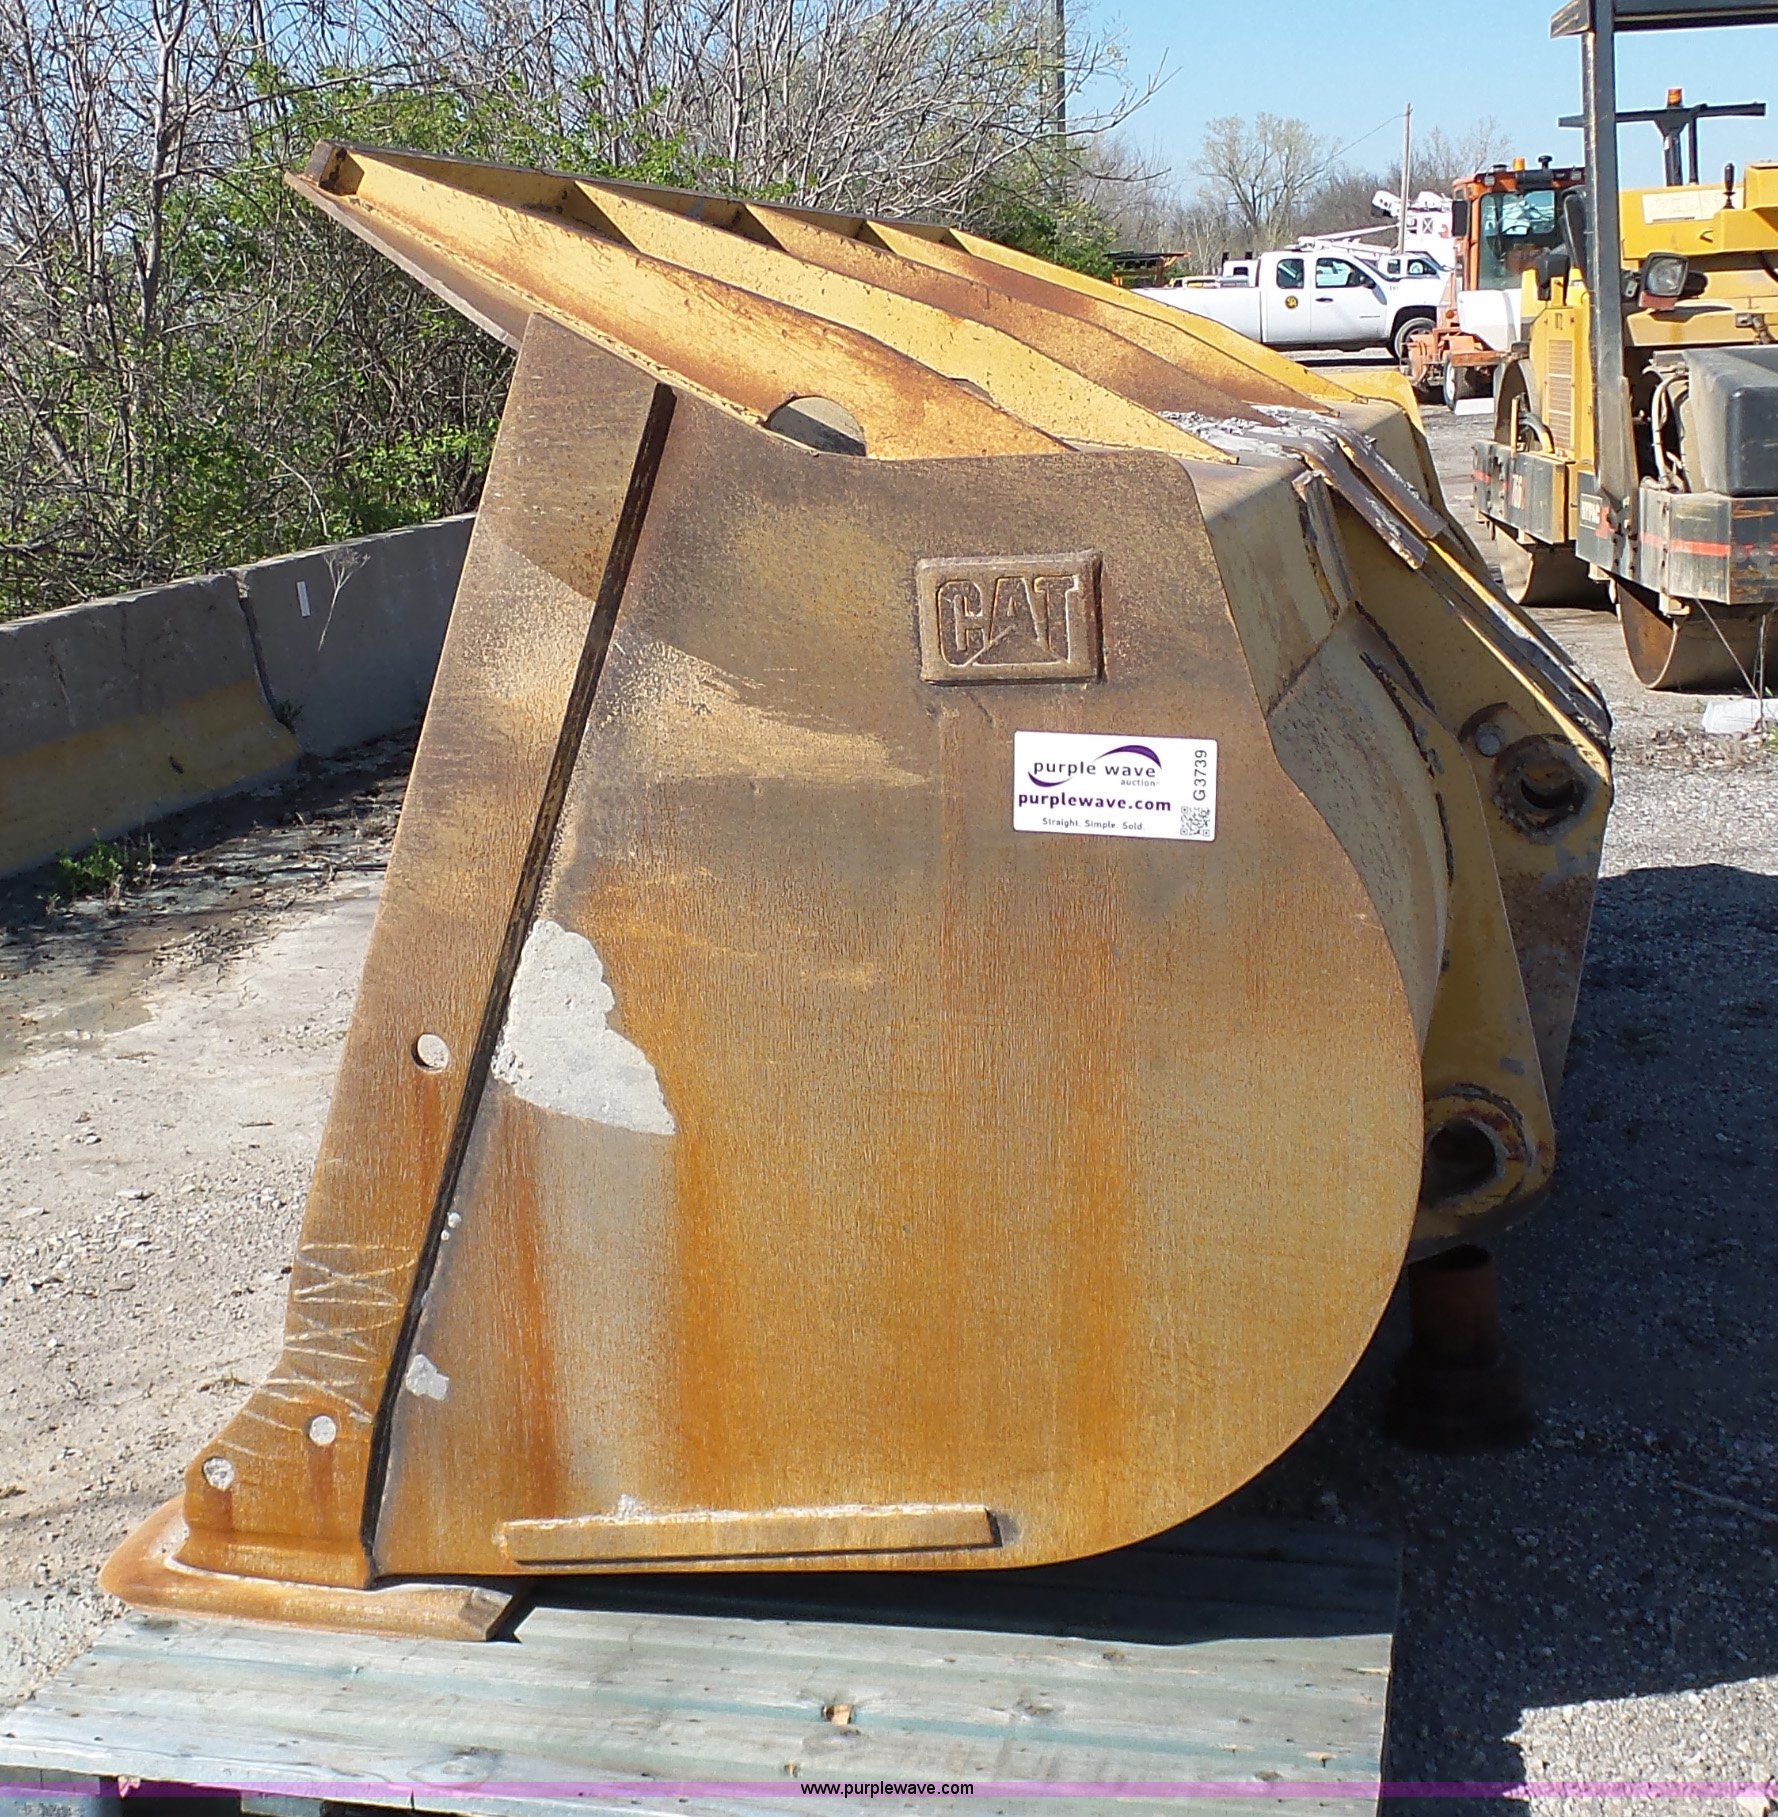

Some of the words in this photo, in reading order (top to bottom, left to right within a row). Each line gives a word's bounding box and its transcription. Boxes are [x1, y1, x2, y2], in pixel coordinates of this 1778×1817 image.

[937, 574, 1080, 668] CAT
[1033, 761, 1097, 777] purple
[1104, 765, 1156, 778] wave
[1192, 749, 1208, 801] G3739
[1120, 778, 1156, 787] auction
[1018, 791, 1171, 811] purplewave.com
[1042, 817, 1081, 829] Straight.
[1084, 819, 1119, 830] Simple.
[1122, 822, 1146, 831] Sold.
